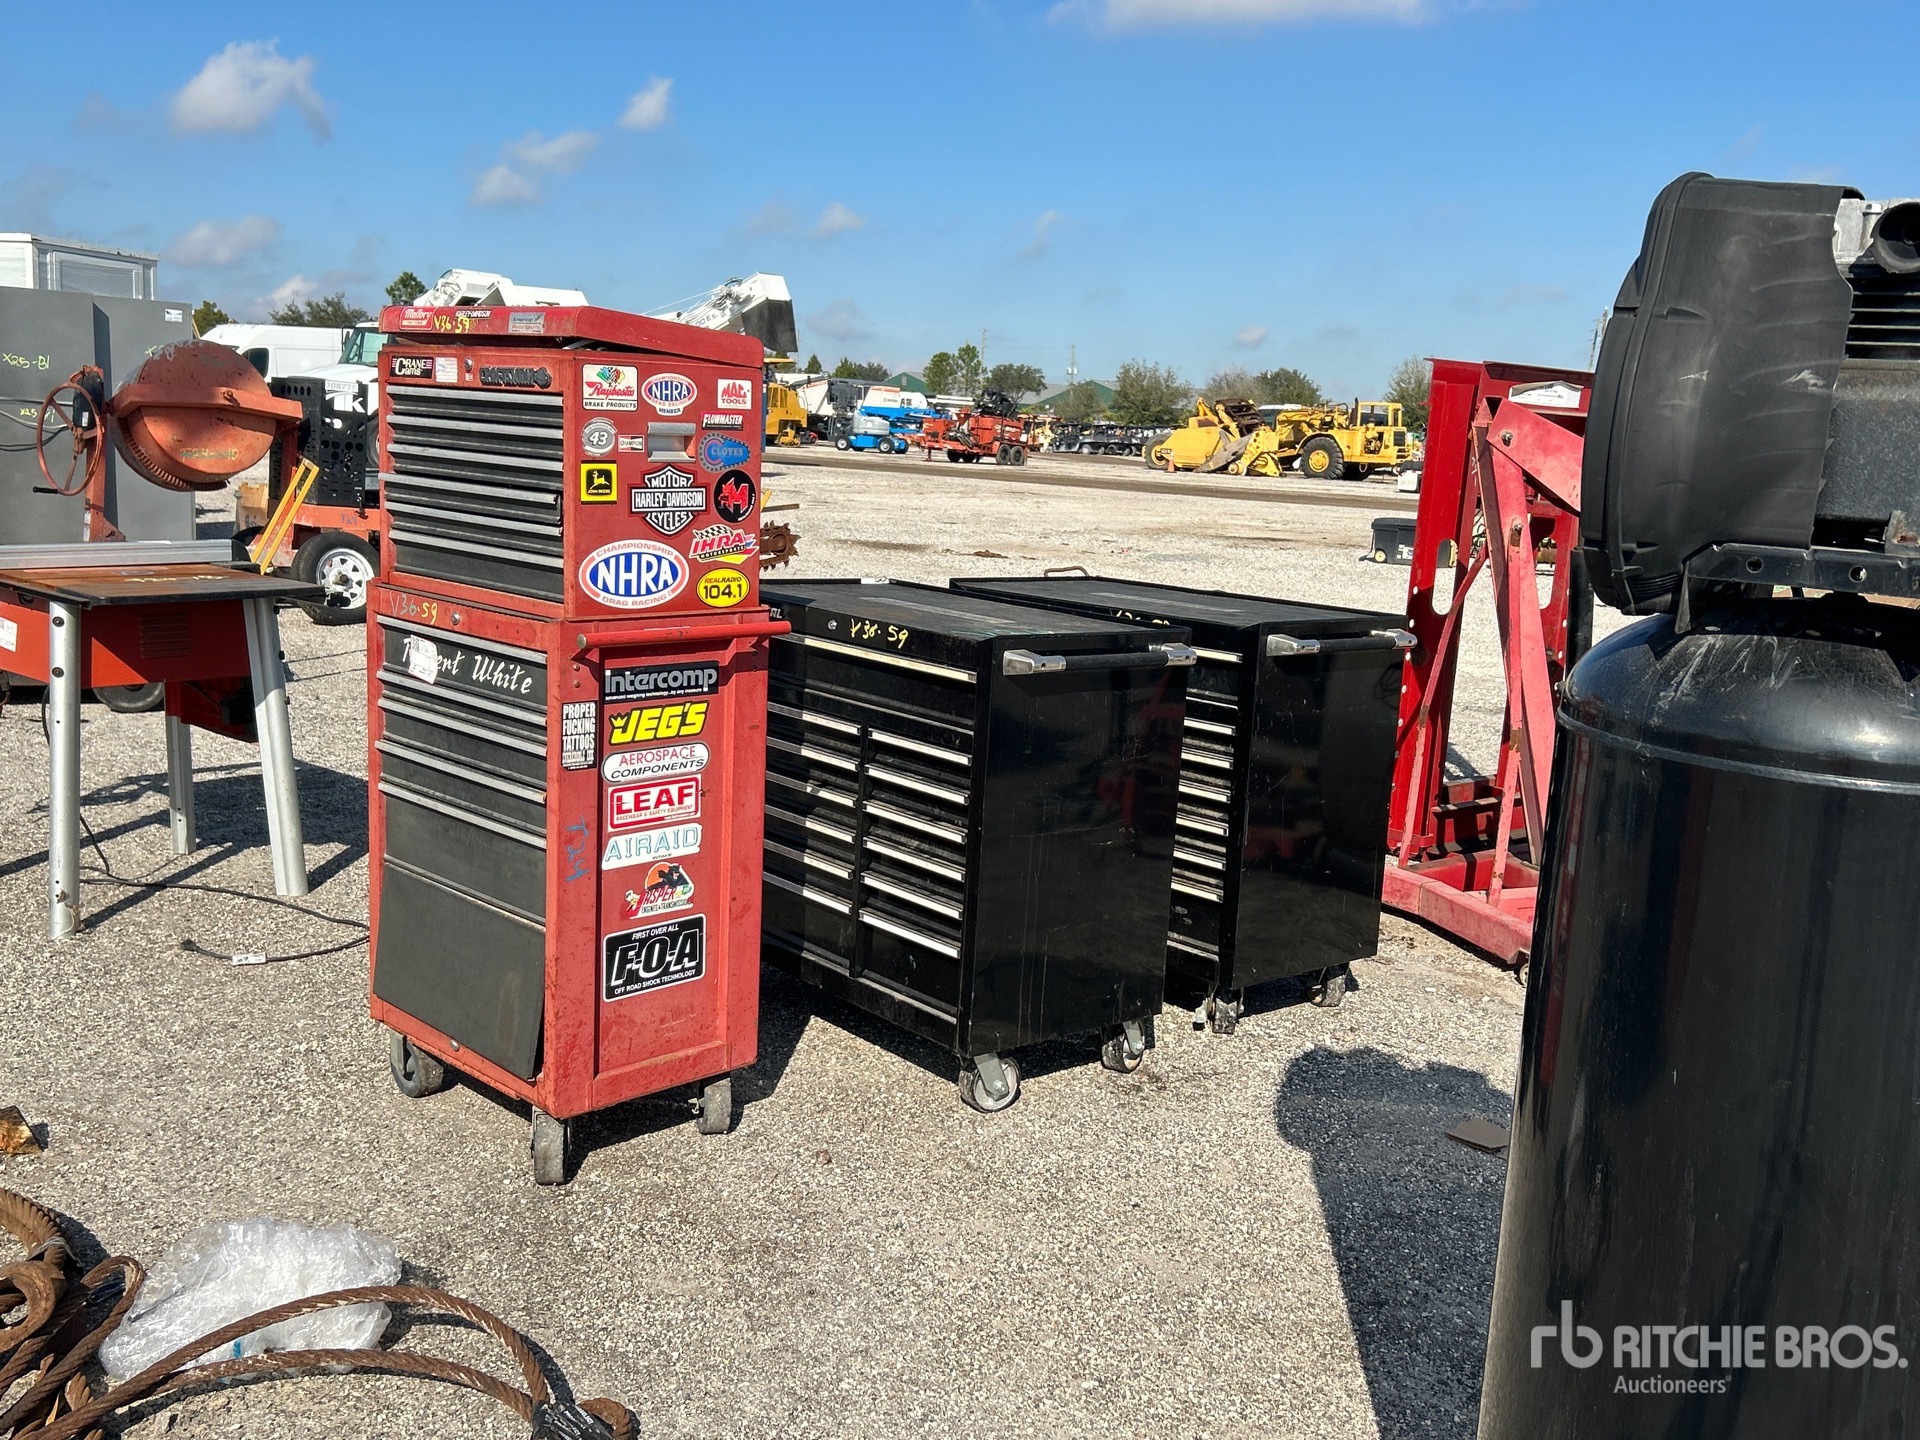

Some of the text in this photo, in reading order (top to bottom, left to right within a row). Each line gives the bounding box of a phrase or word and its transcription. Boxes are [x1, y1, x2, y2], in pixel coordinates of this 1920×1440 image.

[585, 381, 635, 400] Raybestos
[652, 381, 688, 401] NHRA
[721, 381, 747, 398] MAC
[702, 413, 744, 428] FLOWMASTER
[589, 431, 608, 446] 43
[711, 446, 744, 456] CLOYES
[650, 471, 688, 488] MOTOR
[635, 491, 703, 508] HARLEY-DAVIDSON
[651, 511, 688, 531] CYCLES
[596, 542, 674, 557] CHAMPIONSHIP
[692, 532, 744, 554] IHRA
[597, 553, 674, 596] NHRA
[602, 594, 667, 607] DRAG RACING
[703, 583, 742, 600] 104.1
[471, 654, 533, 694] White
[605, 668, 718, 694] Intercomp
[562, 702, 596, 720] PROPER
[562, 717, 596, 736] FUCKING
[610, 702, 709, 744] JEG'S
[562, 733, 595, 752] TATTOOS
[618, 745, 696, 767] AEROSPACE
[610, 758, 705, 779] COMPONENTS
[616, 784, 694, 815] LEAF
[615, 812, 643, 821] RACEWEAR
[667, 804, 693, 813] EQUIPMENT
[605, 826, 699, 862] AIRAID
[632, 930, 650, 941] FIRST
[614, 969, 696, 995] OFF ROAD SHOCK TECHNOLOGY
